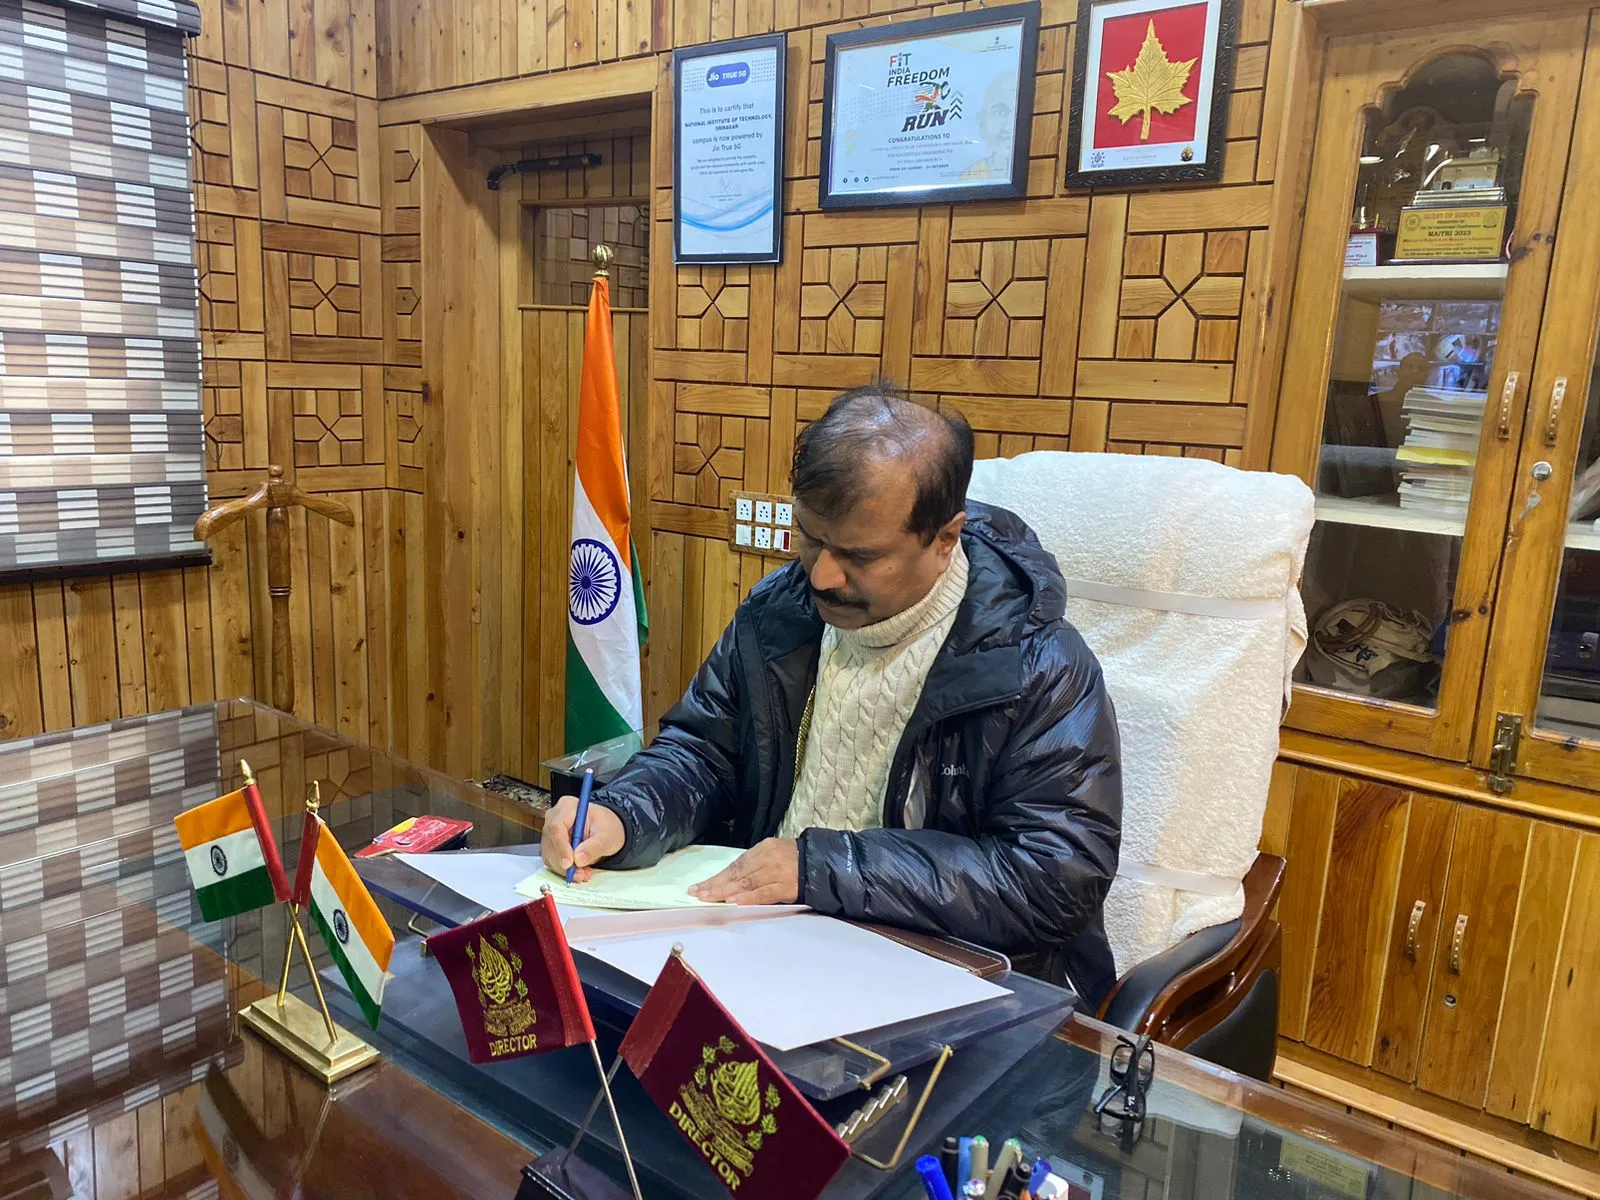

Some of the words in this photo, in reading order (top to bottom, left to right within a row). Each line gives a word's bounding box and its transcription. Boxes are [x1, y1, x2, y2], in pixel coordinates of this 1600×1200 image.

[708, 72, 719, 81] Jio
[888, 67, 911, 76] INDIA
[887, 67, 950, 88] FREEDOM
[724, 103, 741, 112] certify
[901, 109, 949, 132] RUN
[731, 132, 755, 141] powered
[756, 131, 763, 139] by
[888, 133, 942, 144] CONGRATULATIONS
[489, 1033, 538, 1057] DIRECTOR
[668, 1100, 741, 1191] DIRECTOR
